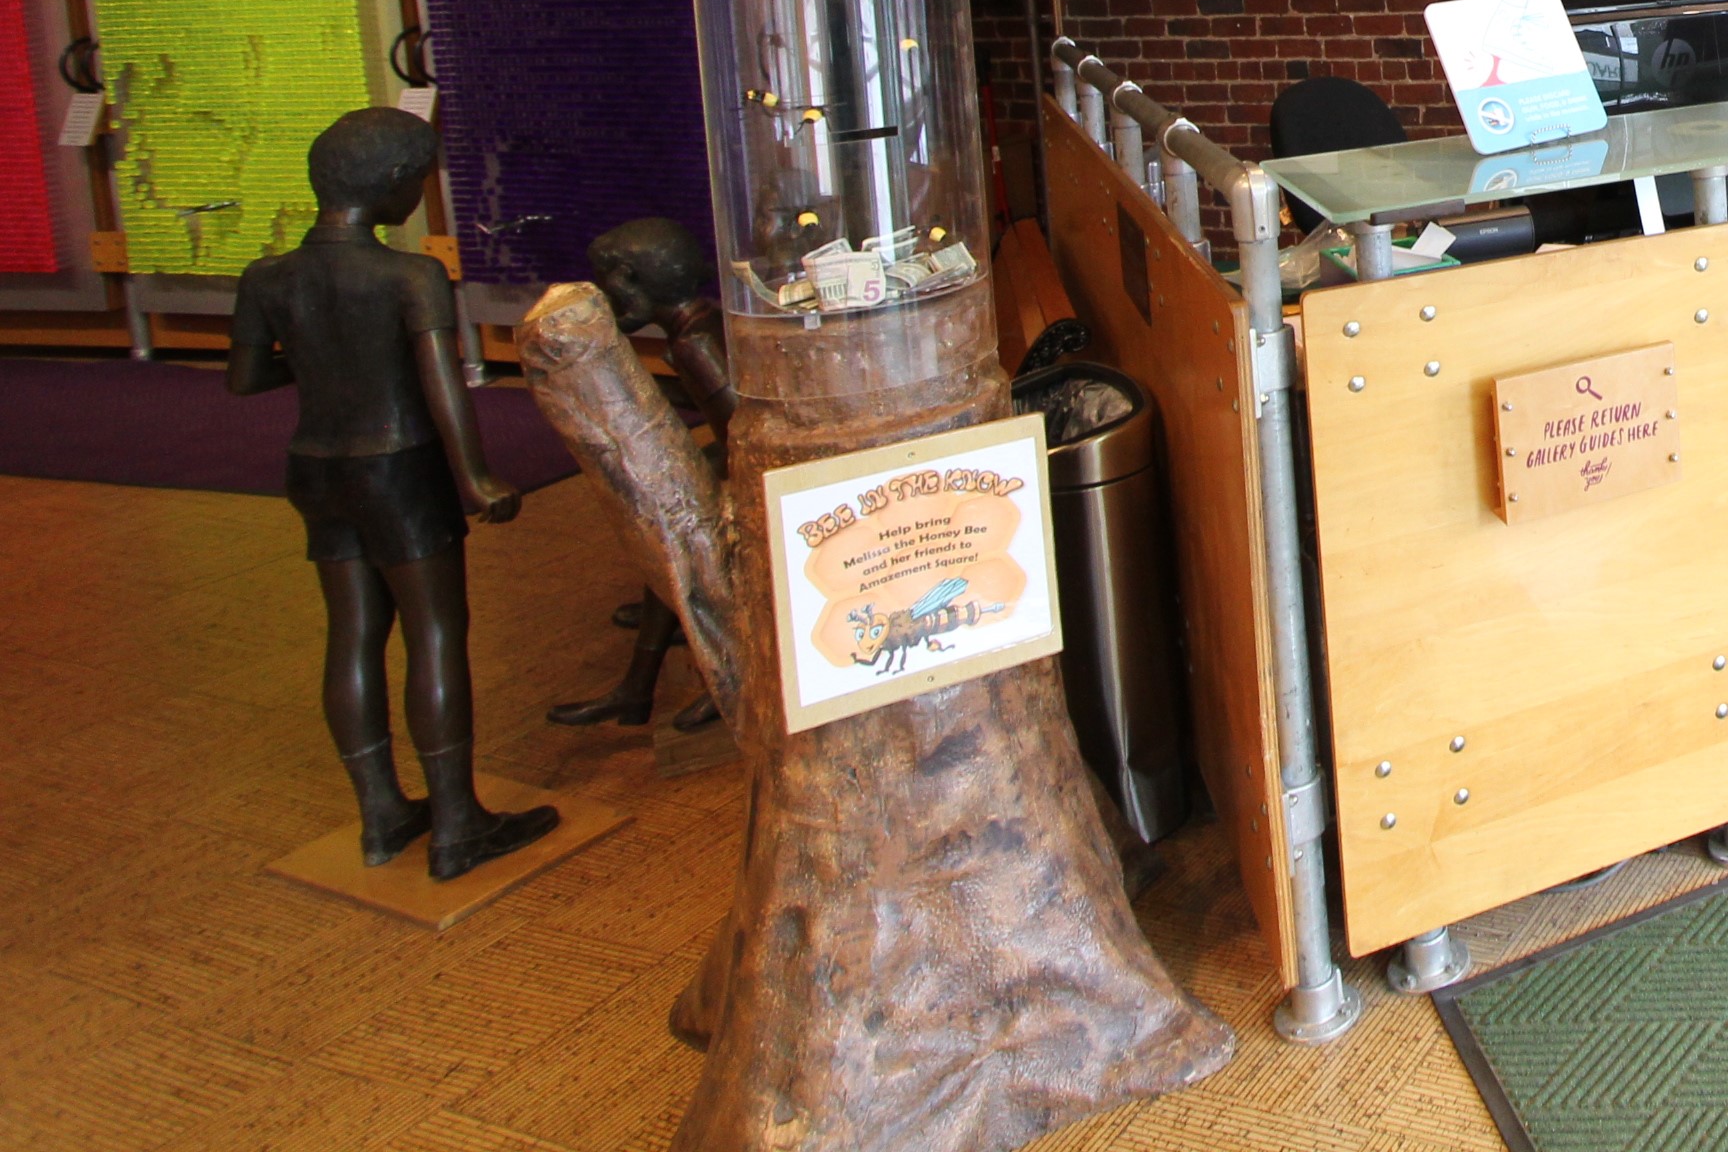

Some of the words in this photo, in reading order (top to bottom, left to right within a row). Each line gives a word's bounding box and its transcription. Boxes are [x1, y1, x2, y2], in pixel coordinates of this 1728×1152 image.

[863, 280, 880, 302] 5
[1543, 414, 1586, 441] PLEASE
[1590, 401, 1642, 430] RETURN
[1526, 441, 1576, 468] GALLERY
[1579, 427, 1624, 454] GUIDES
[1627, 420, 1659, 443] HERE
[797, 504, 857, 548] BEE
[857, 485, 889, 516] IN
[888, 469, 941, 502] THE
[943, 468, 1024, 497] KNOW
[843, 546, 891, 570] Melissa
[894, 538, 916, 551] the
[919, 528, 961, 546] Honey
[964, 524, 988, 535] Bee
[879, 524, 912, 542] Help
[915, 515, 952, 532] bring
[858, 562, 932, 593] Amazement
[934, 553, 979, 571] Square!
[862, 560, 888, 577] and
[890, 552, 911, 567] her
[914, 541, 957, 561] friends
[960, 540, 972, 550] to
